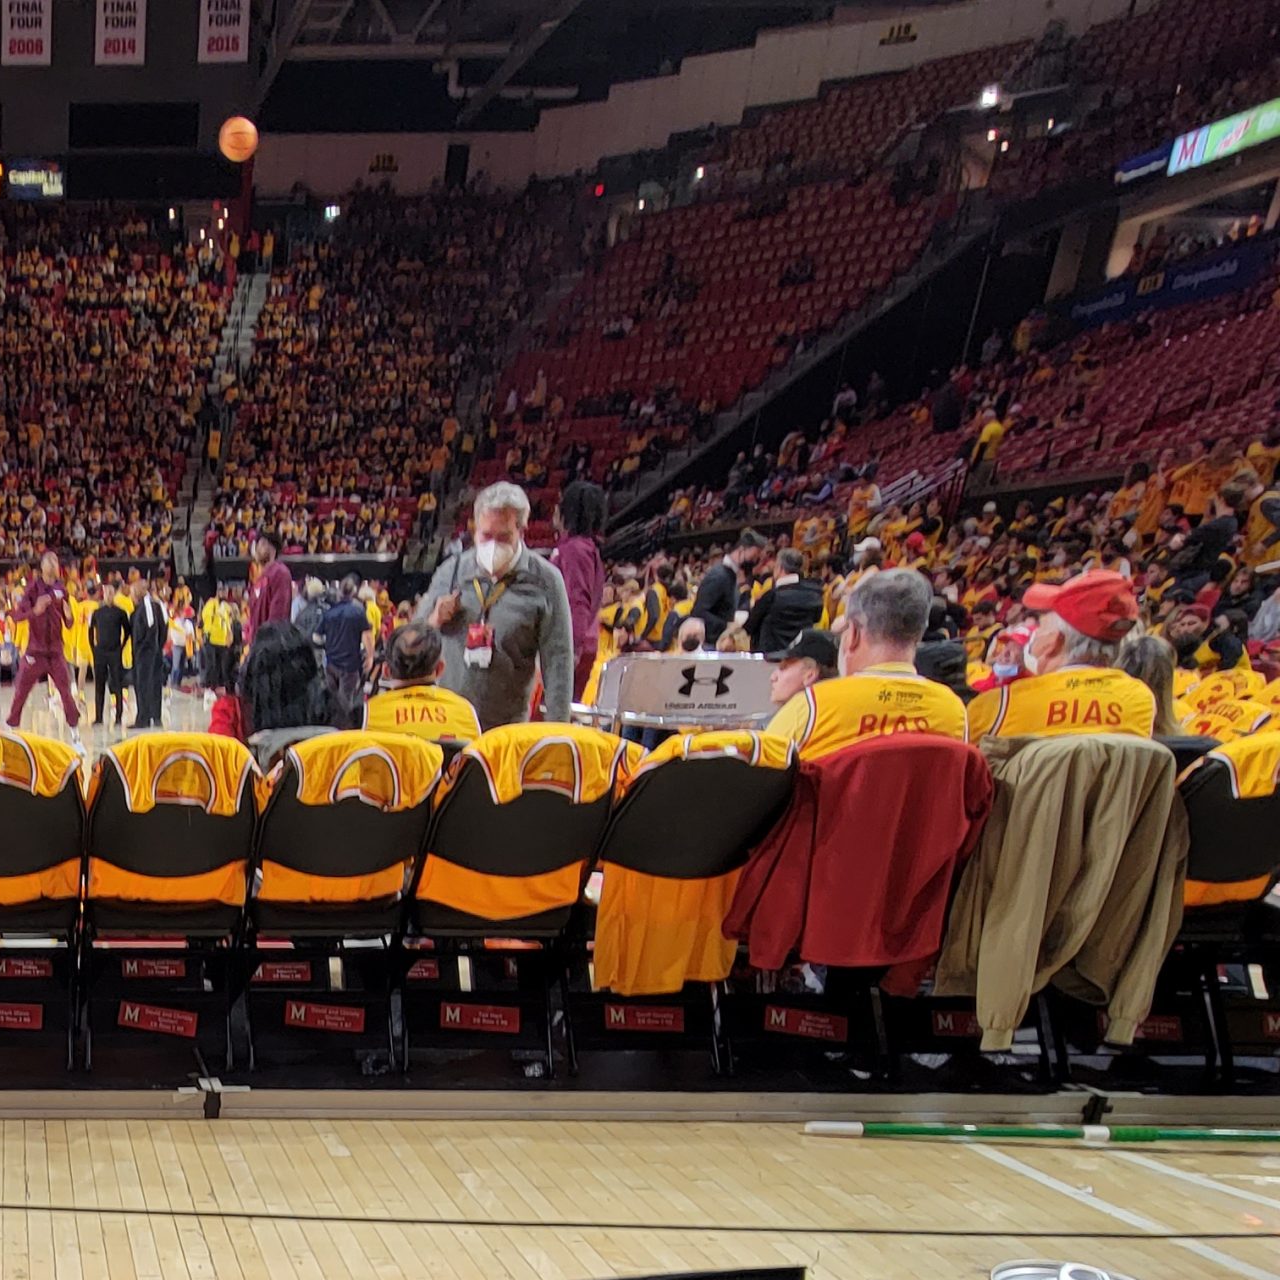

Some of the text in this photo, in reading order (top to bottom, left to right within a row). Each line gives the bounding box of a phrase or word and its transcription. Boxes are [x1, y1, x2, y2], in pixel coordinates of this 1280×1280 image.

[9, 2, 43, 14] FINAL
[103, 1, 137, 14] FINAL
[207, 0, 241, 12] FINAL
[10, 17, 42, 30] FOUR
[105, 16, 136, 29] FOUR
[209, 14, 240, 28] FOUR
[396, 703, 447, 725] BIAS
[1046, 700, 1123, 726] BIAS
[125, 1005, 140, 1023] M
[291, 1003, 306, 1021] M
[446, 1006, 460, 1023] M
